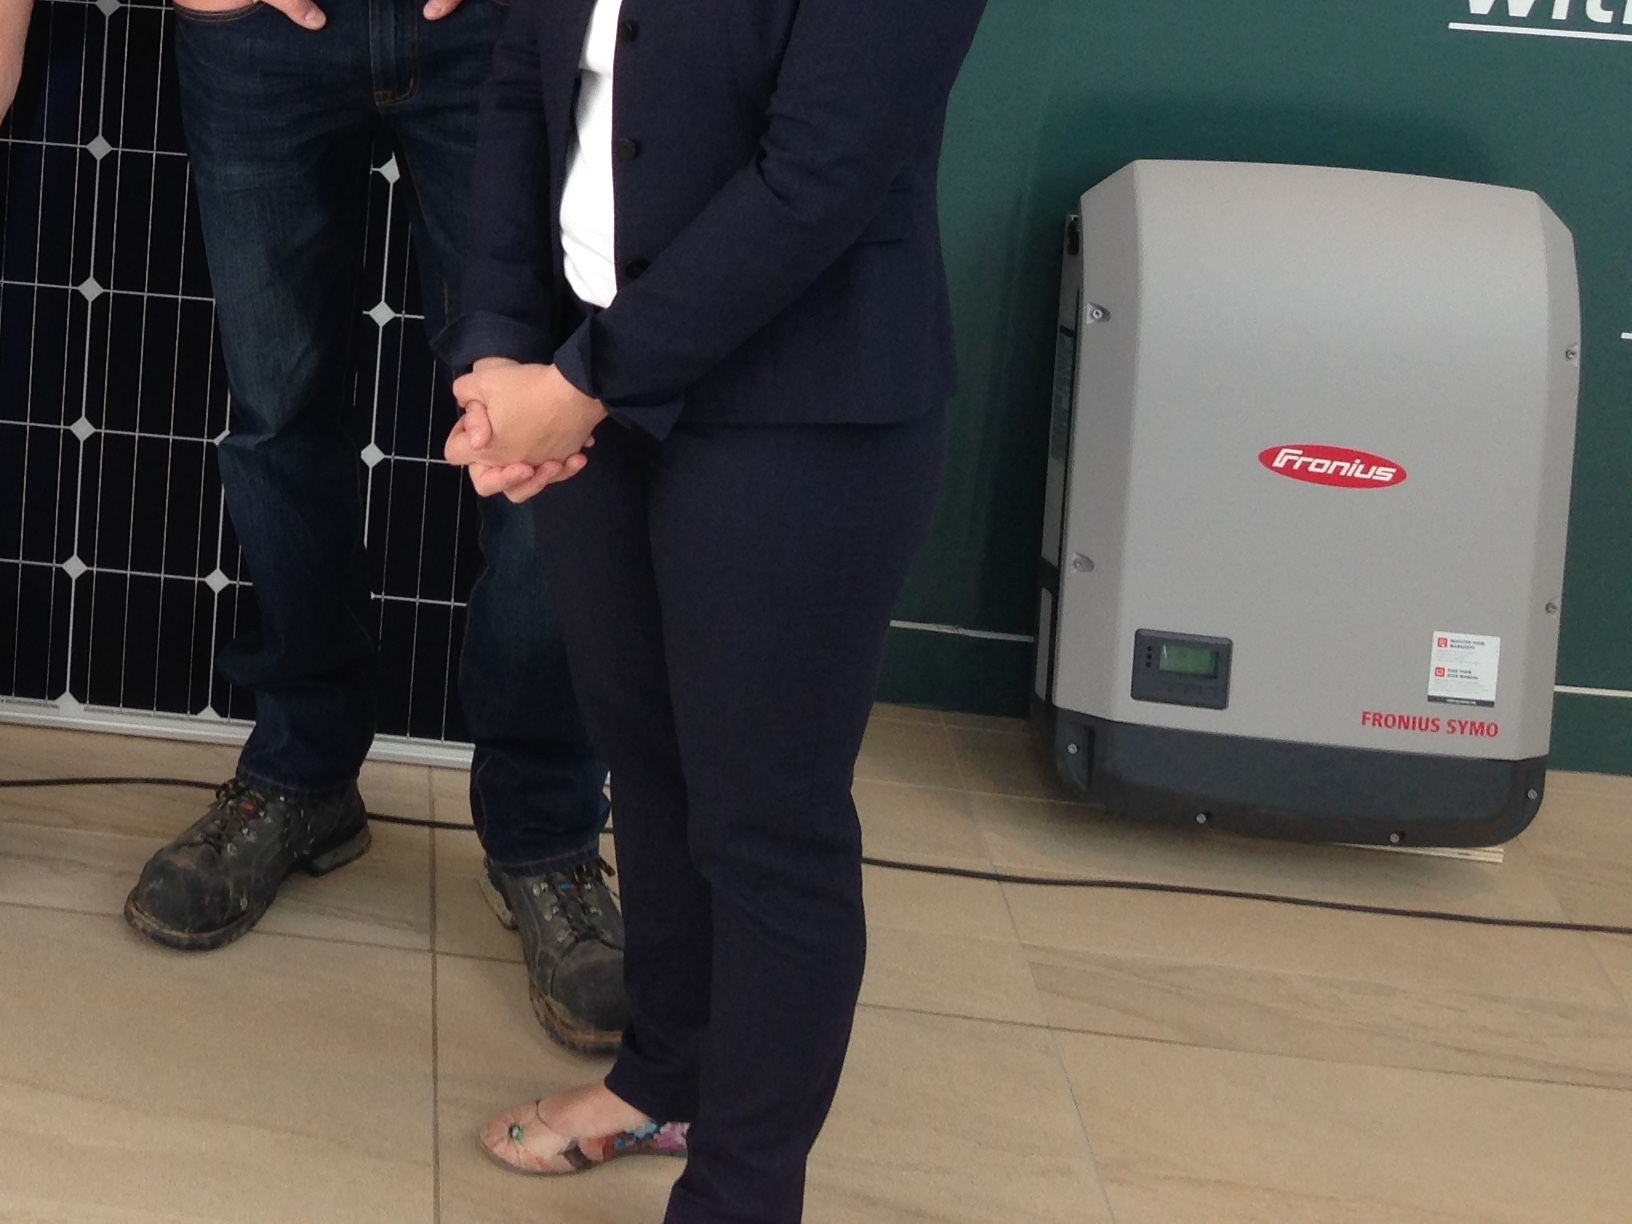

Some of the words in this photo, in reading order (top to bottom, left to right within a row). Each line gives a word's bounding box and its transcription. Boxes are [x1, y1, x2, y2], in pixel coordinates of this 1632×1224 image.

[1272, 448, 1397, 482] Fronius
[1361, 711, 1441, 733] FRONIUS
[1446, 719, 1499, 738] SYMO
